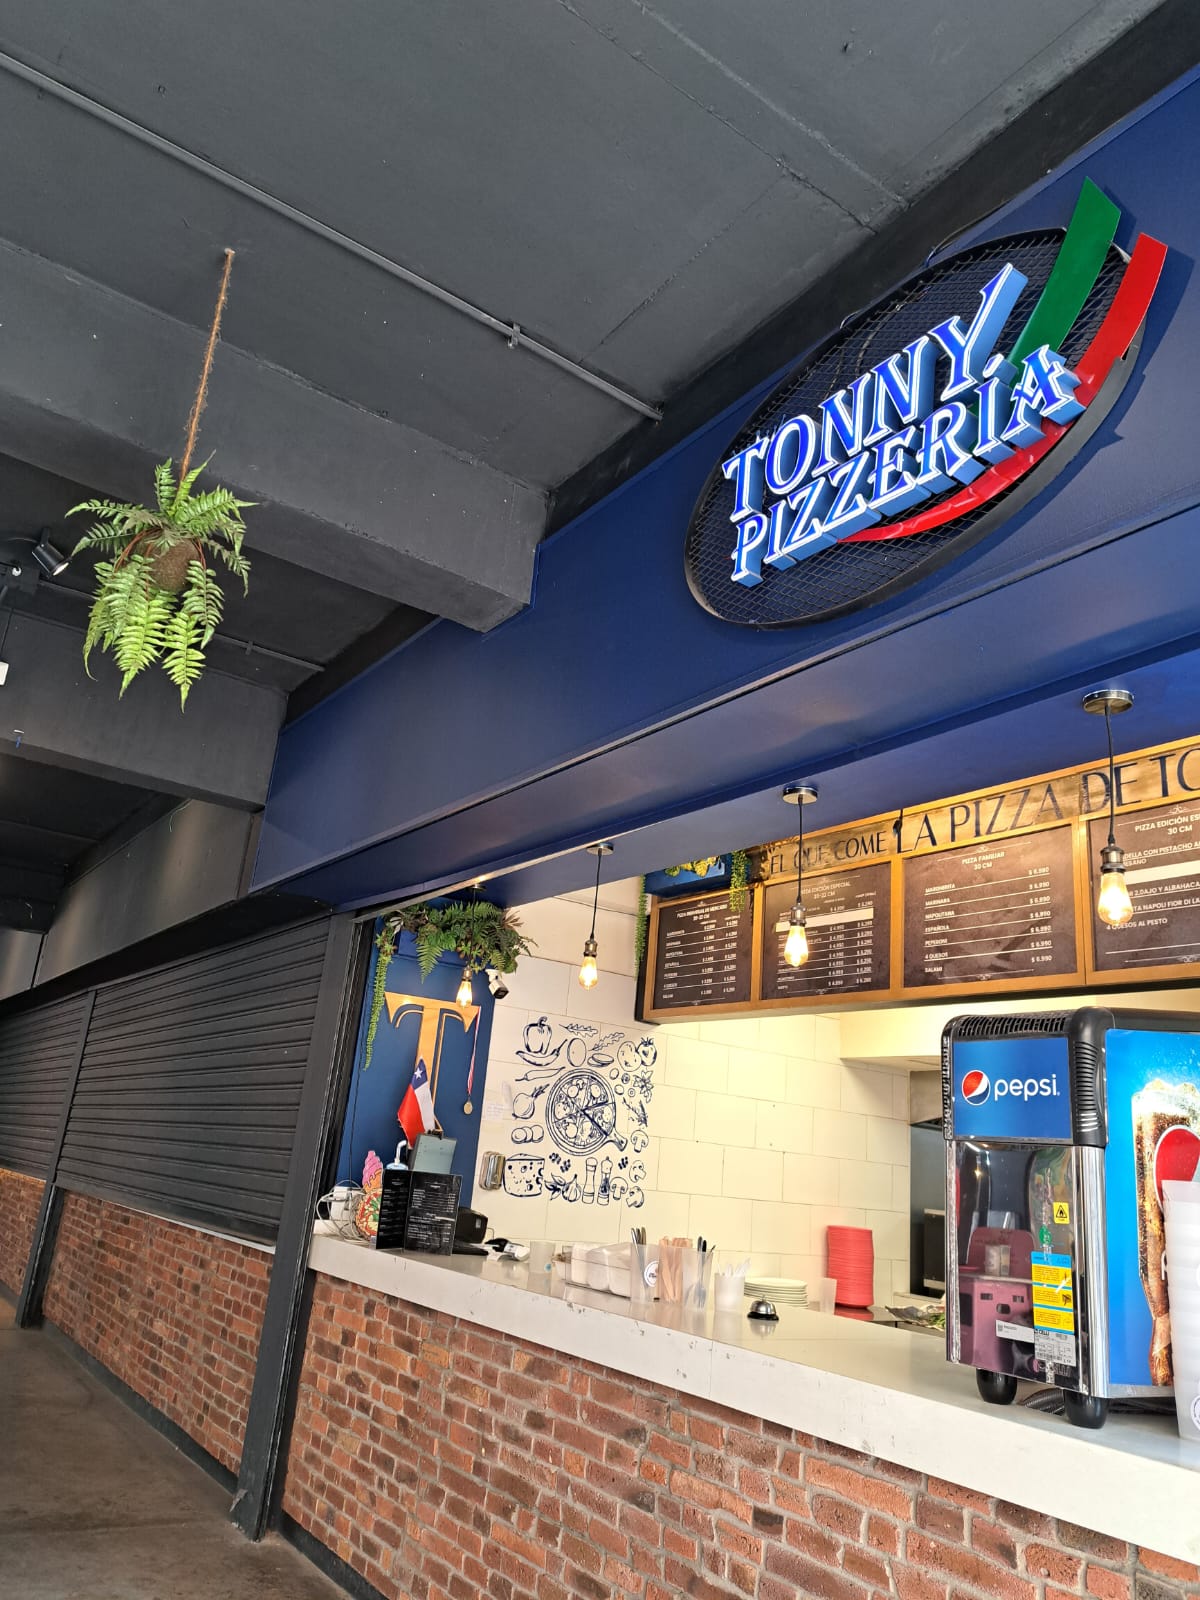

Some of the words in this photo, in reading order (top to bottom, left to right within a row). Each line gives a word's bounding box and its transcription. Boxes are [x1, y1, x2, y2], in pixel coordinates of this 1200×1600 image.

[721, 262, 1026, 523] TONNY
[730, 344, 1083, 585] PIZZERIA
[770, 854, 787, 875] EL
[834, 830, 886, 861] COME
[896, 813, 938, 855] LA
[950, 783, 1064, 843] PIZZA
[1081, 762, 1142, 814] DE
[1134, 822, 1156, 832] PIZZA
[1156, 816, 1188, 828] EDICIÓN
[1168, 827, 1178, 835] 30
[1179, 824, 1192, 832] CM
[979, 852, 1004, 861] FAMILIAR
[1124, 851, 1142, 860] DELLA
[1143, 849, 1158, 857] CON
[1146, 918, 1168, 926] PESTO
[994, 1074, 1056, 1101] pepsi
